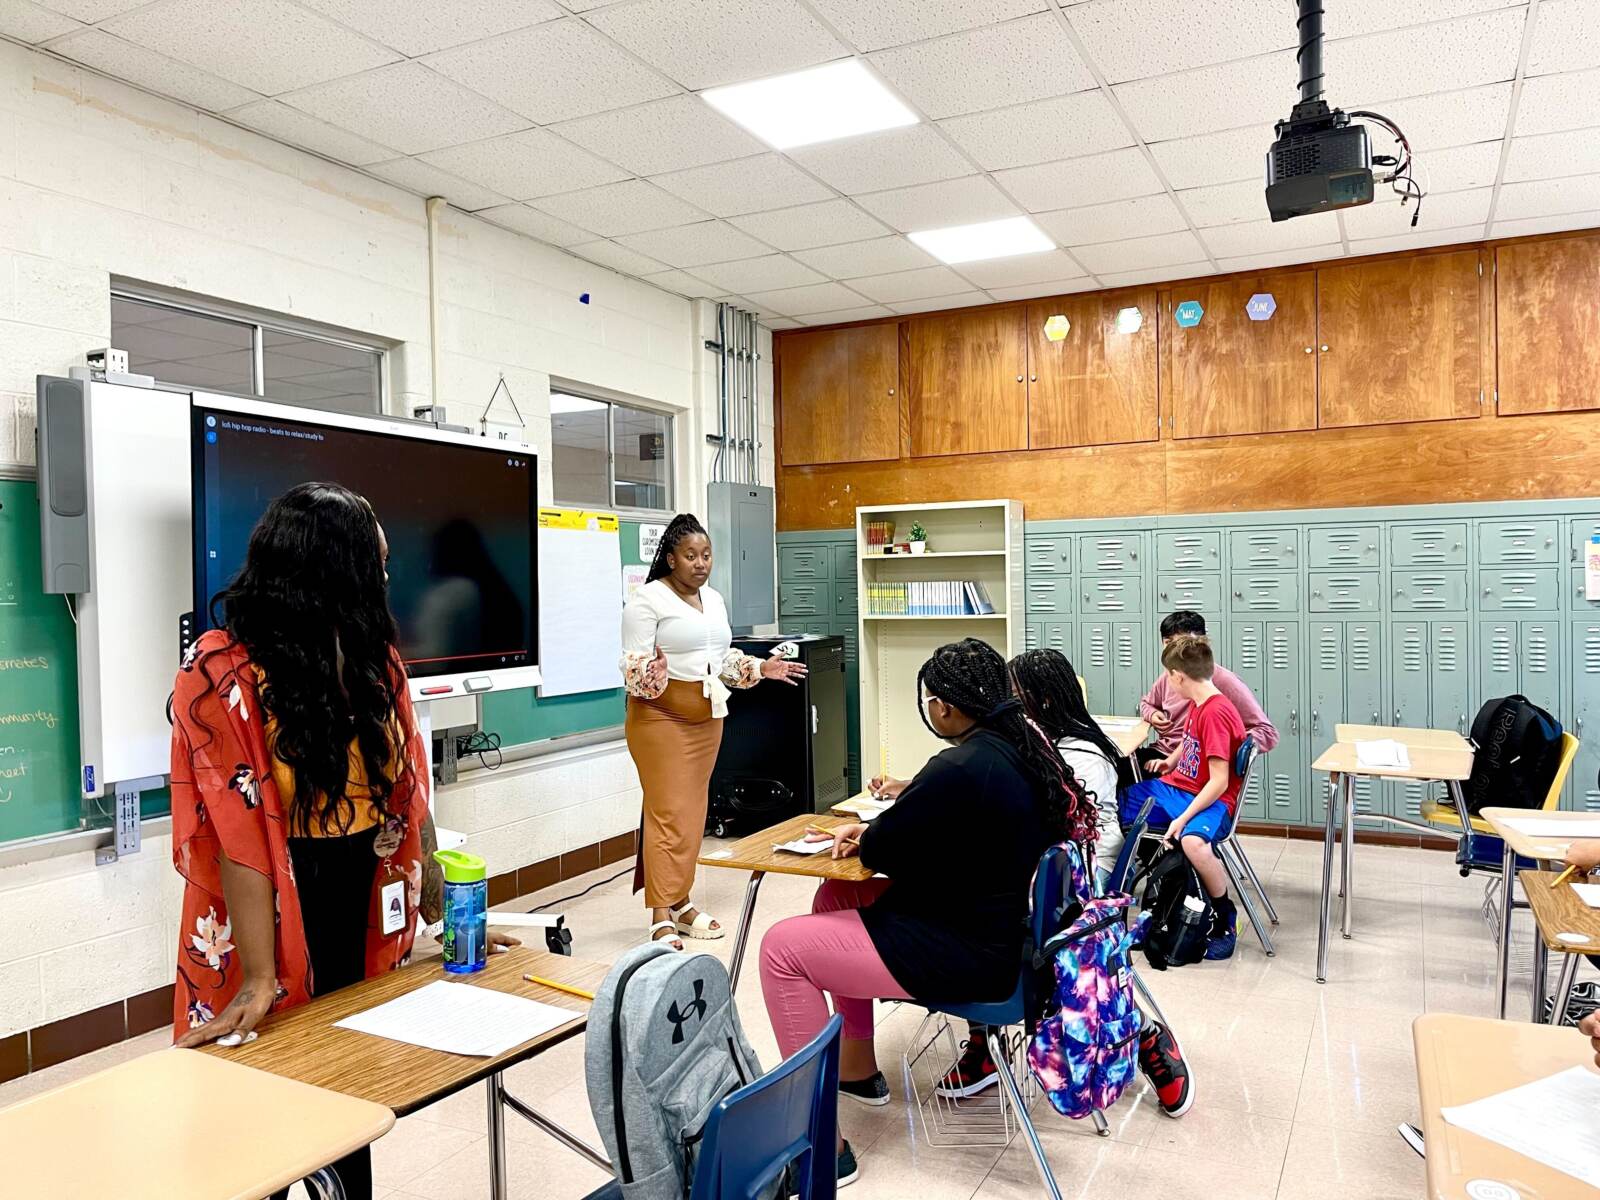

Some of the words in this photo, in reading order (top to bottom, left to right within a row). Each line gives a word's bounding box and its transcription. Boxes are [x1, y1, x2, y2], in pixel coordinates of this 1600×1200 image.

[231, 421, 241, 430] hip
[241, 423, 252, 432] hop
[252, 424, 266, 433] radio
[269, 426, 285, 436] beats
